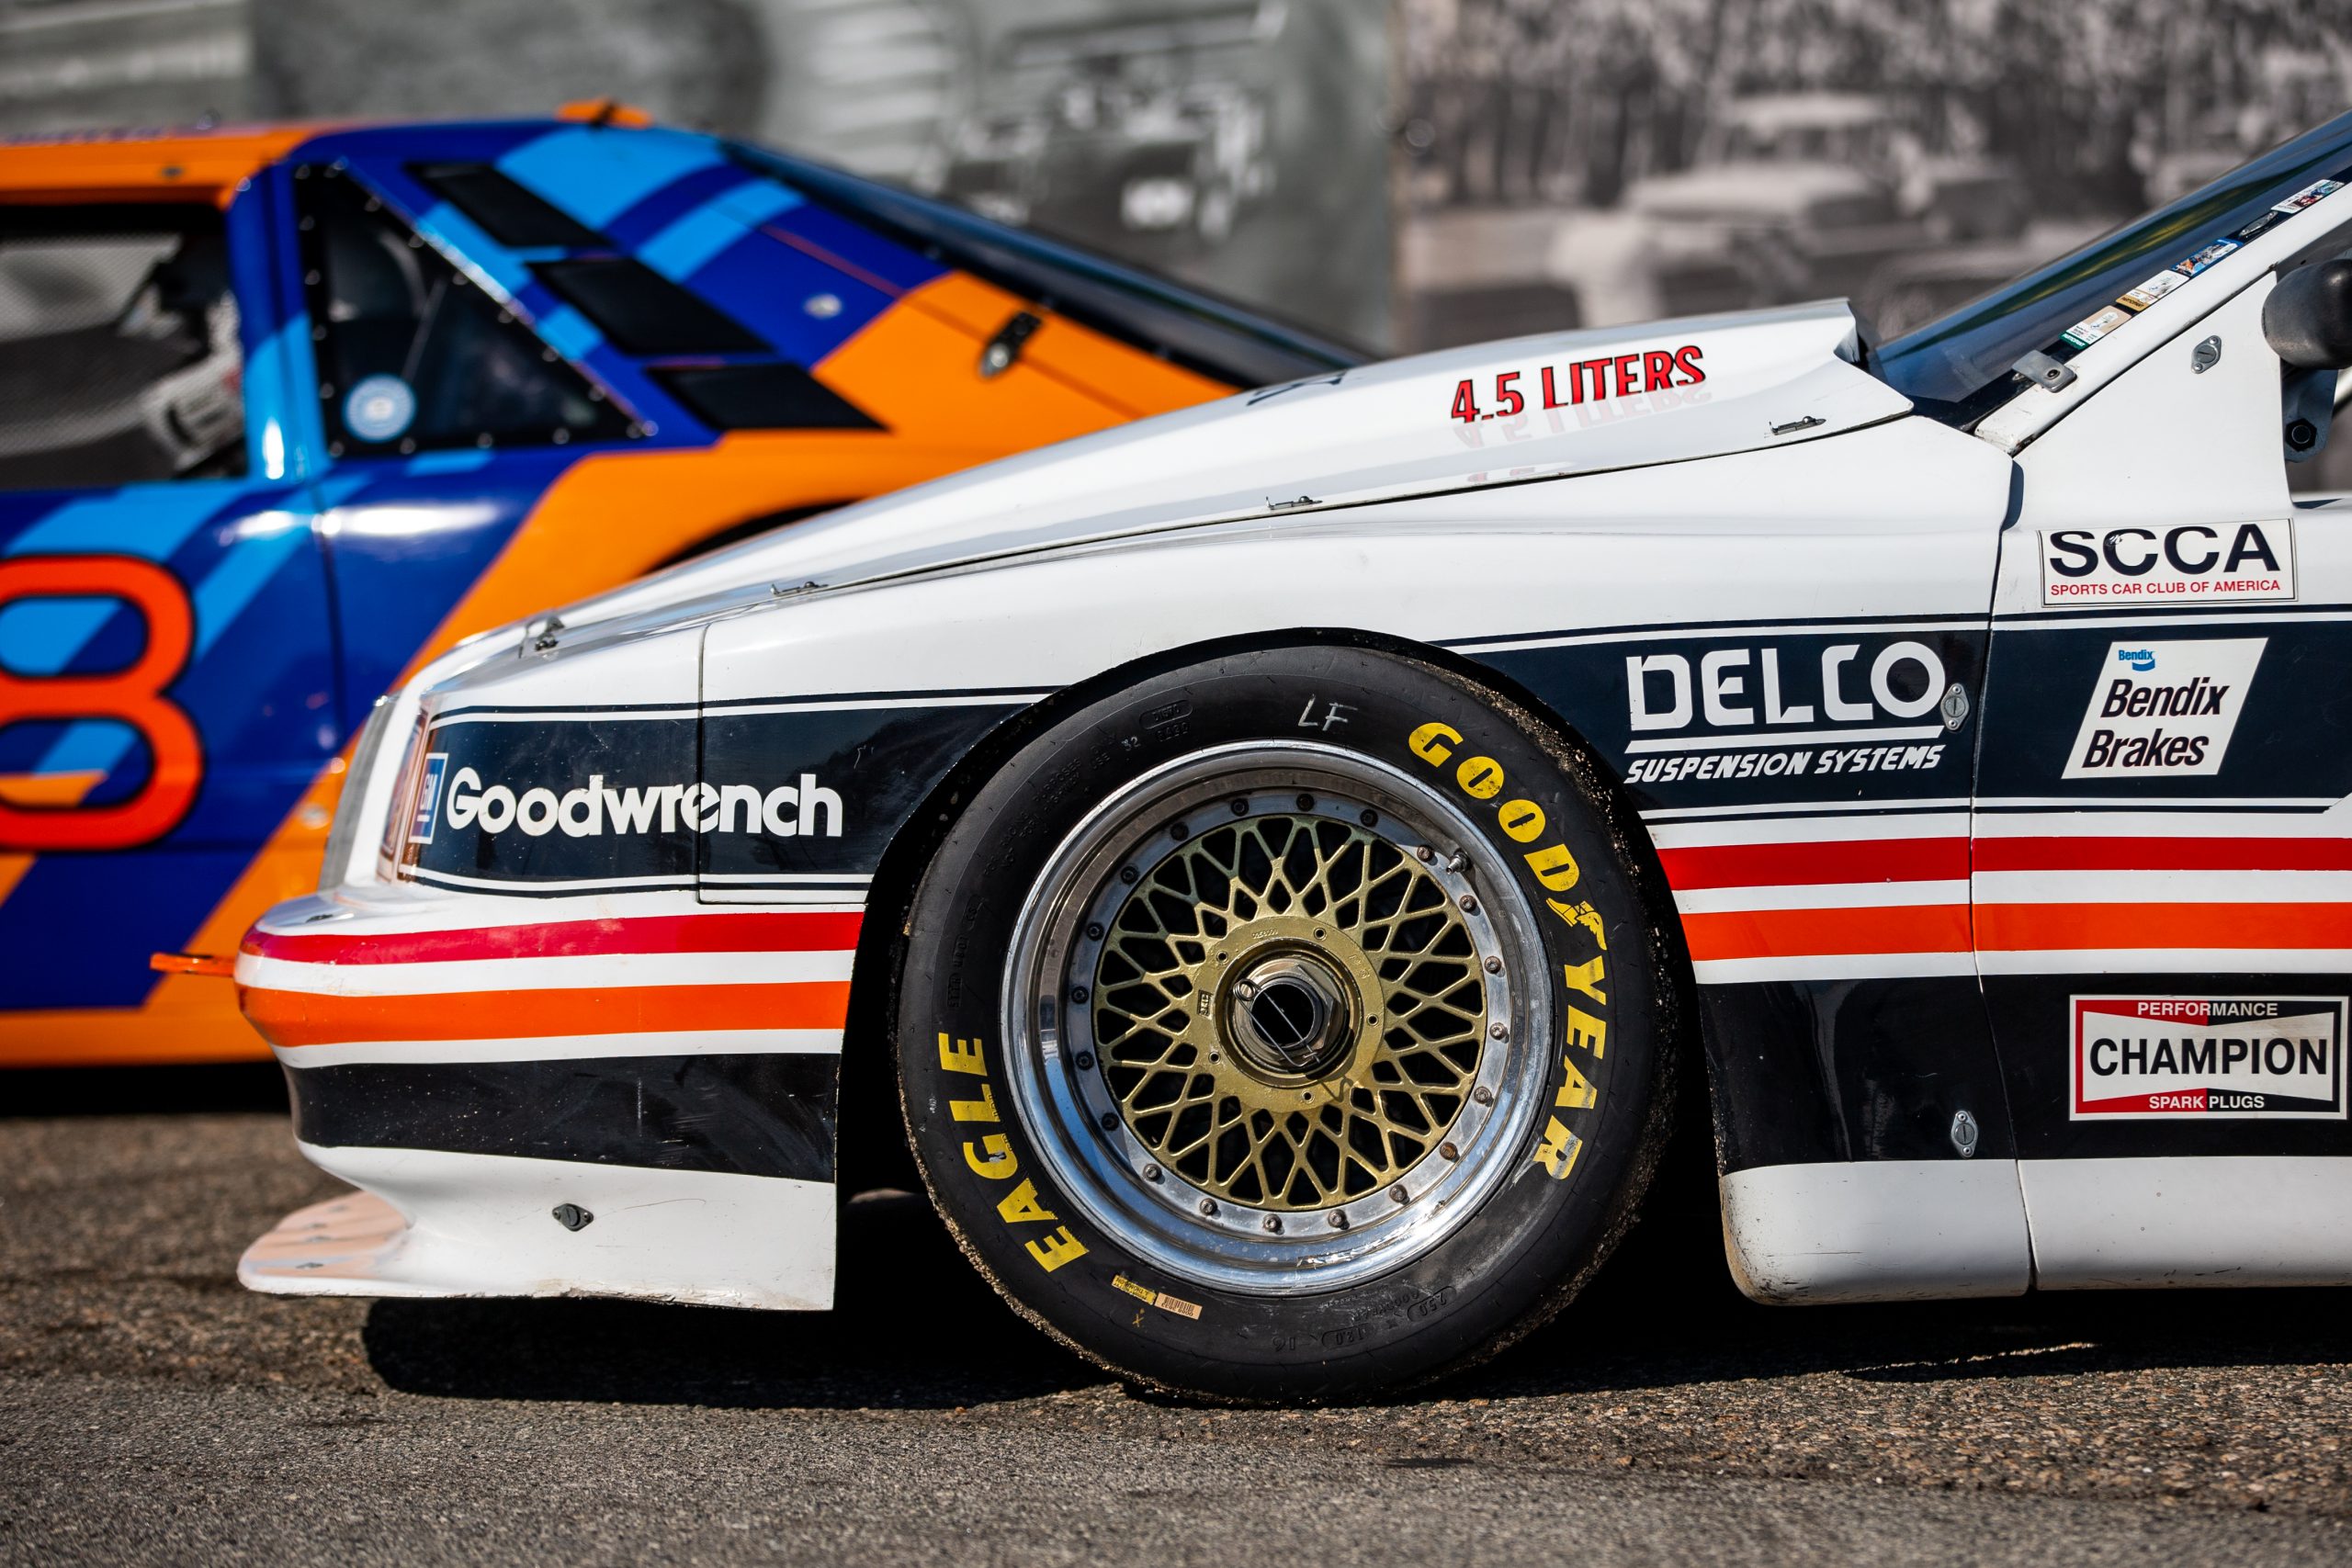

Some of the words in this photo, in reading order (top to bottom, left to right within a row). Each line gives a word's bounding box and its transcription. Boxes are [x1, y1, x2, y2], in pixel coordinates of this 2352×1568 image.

[1451, 370, 1525, 424] 4.5
[1541, 344, 1706, 411] LITERS
[2049, 523, 2281, 578] SCCA
[2050, 583, 2109, 596] SPORTS
[2111, 582, 2143, 595] CAR
[2145, 581, 2187, 594] CLUB
[2188, 581, 2210, 593] OF
[2212, 579, 2281, 592] AMERICA
[2118, 649, 2154, 661] Bendix
[0, 551, 206, 852] 8
[1625, 640, 1946, 732] DELCO
[2100, 676, 2231, 718] Bendix
[1296, 693, 1359, 732] LF
[1623, 751, 1814, 785] SUSPENSION
[1815, 744, 1947, 774] SYSTEMS
[2081, 728, 2210, 769] Brakes
[446, 766, 843, 838] Goodwrench
[1408, 722, 1608, 1181] GOODYEAR
[2137, 1001, 2278, 1017] PERFORMANCE
[2088, 1037, 2328, 1077] CHAMPION
[2148, 1095, 2205, 1110] SPARK
[2208, 1095, 2265, 1110] PLUGS
[938, 1032, 1090, 1273] EAGLE
